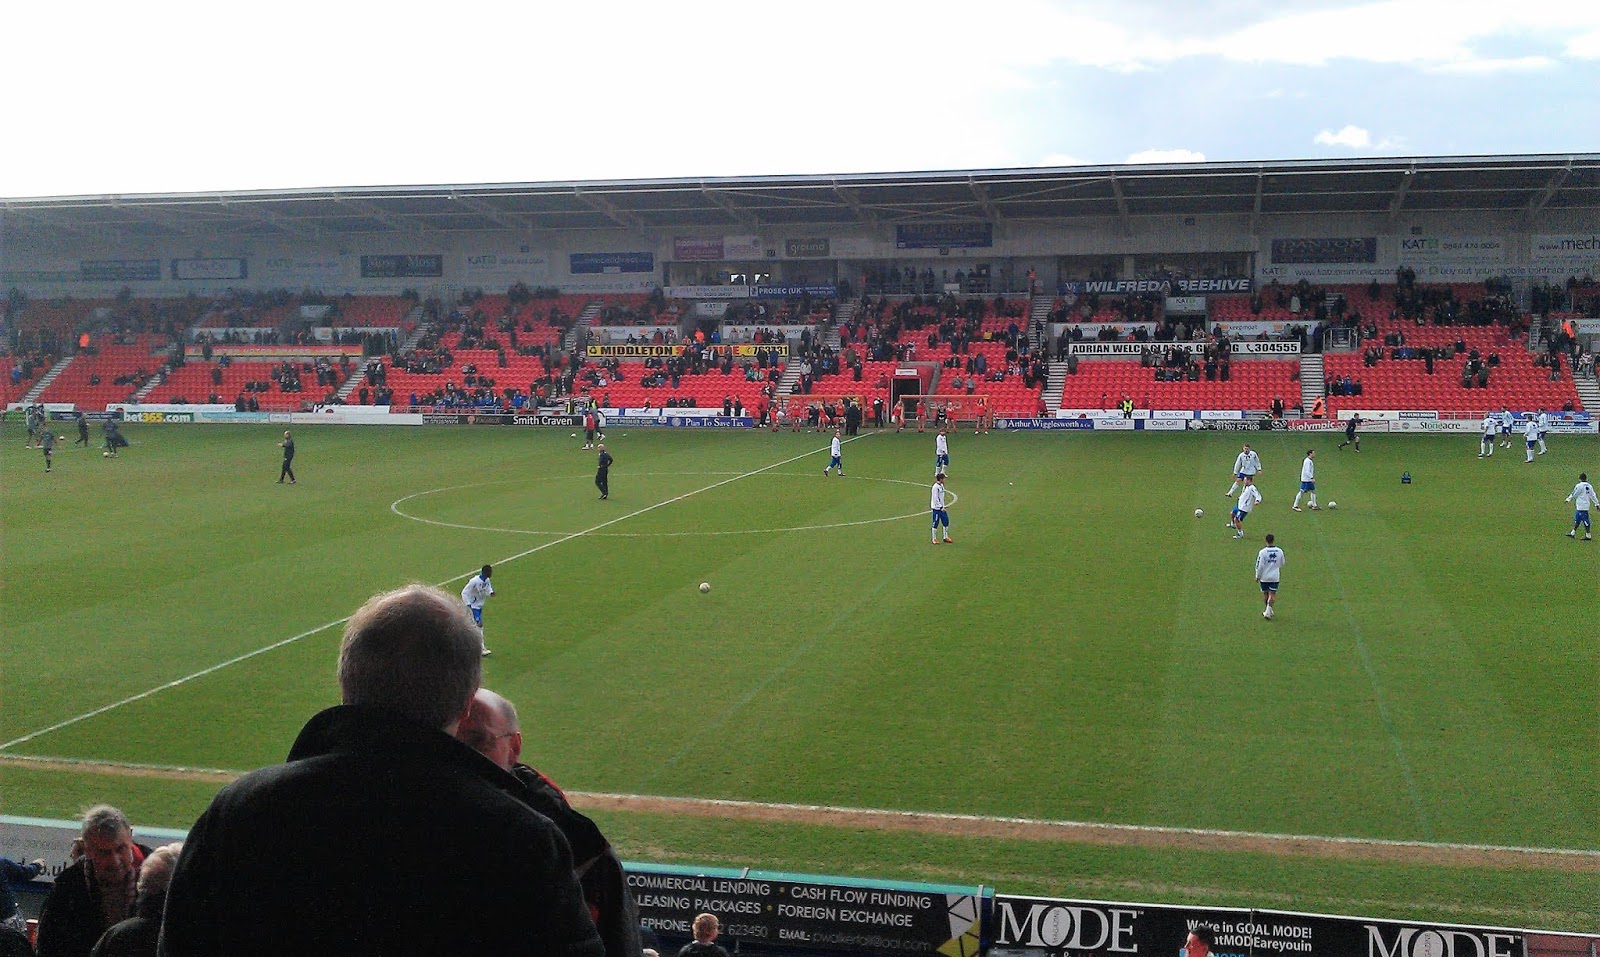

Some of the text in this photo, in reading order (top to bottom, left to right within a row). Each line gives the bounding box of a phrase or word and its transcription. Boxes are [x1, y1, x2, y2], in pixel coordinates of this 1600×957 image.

[759, 287, 787, 295] PROSEC
[600, 346, 673, 356] MIDDLETON
[1072, 343, 1110, 353] ADRIAN
[1255, 343, 1298, 353] 304555
[123, 411, 191, 423] bet365.com
[513, 416, 573, 426] Smith Craven
[702, 417, 713, 427] To
[714, 417, 730, 427] Save
[731, 417, 745, 427] Tax
[1007, 420, 1030, 428] Arthur
[1031, 419, 1080, 429] Wigglesworth
[1420, 421, 1461, 430] Stoneacre
[627, 875, 932, 910] COMMERCIAL LENDING CASH FLOW FUNDING
[637, 894, 914, 928] LEASING PACKAGES FOREIGN EXCHANGE
[641, 917, 691, 933] EPHONE:
[779, 928, 811, 941] EMAIL:
[996, 902, 1137, 953] MODE
[1222, 922, 1234, 934] in
[1236, 923, 1270, 937] GOAL
[1273, 926, 1313, 939] MODE!
